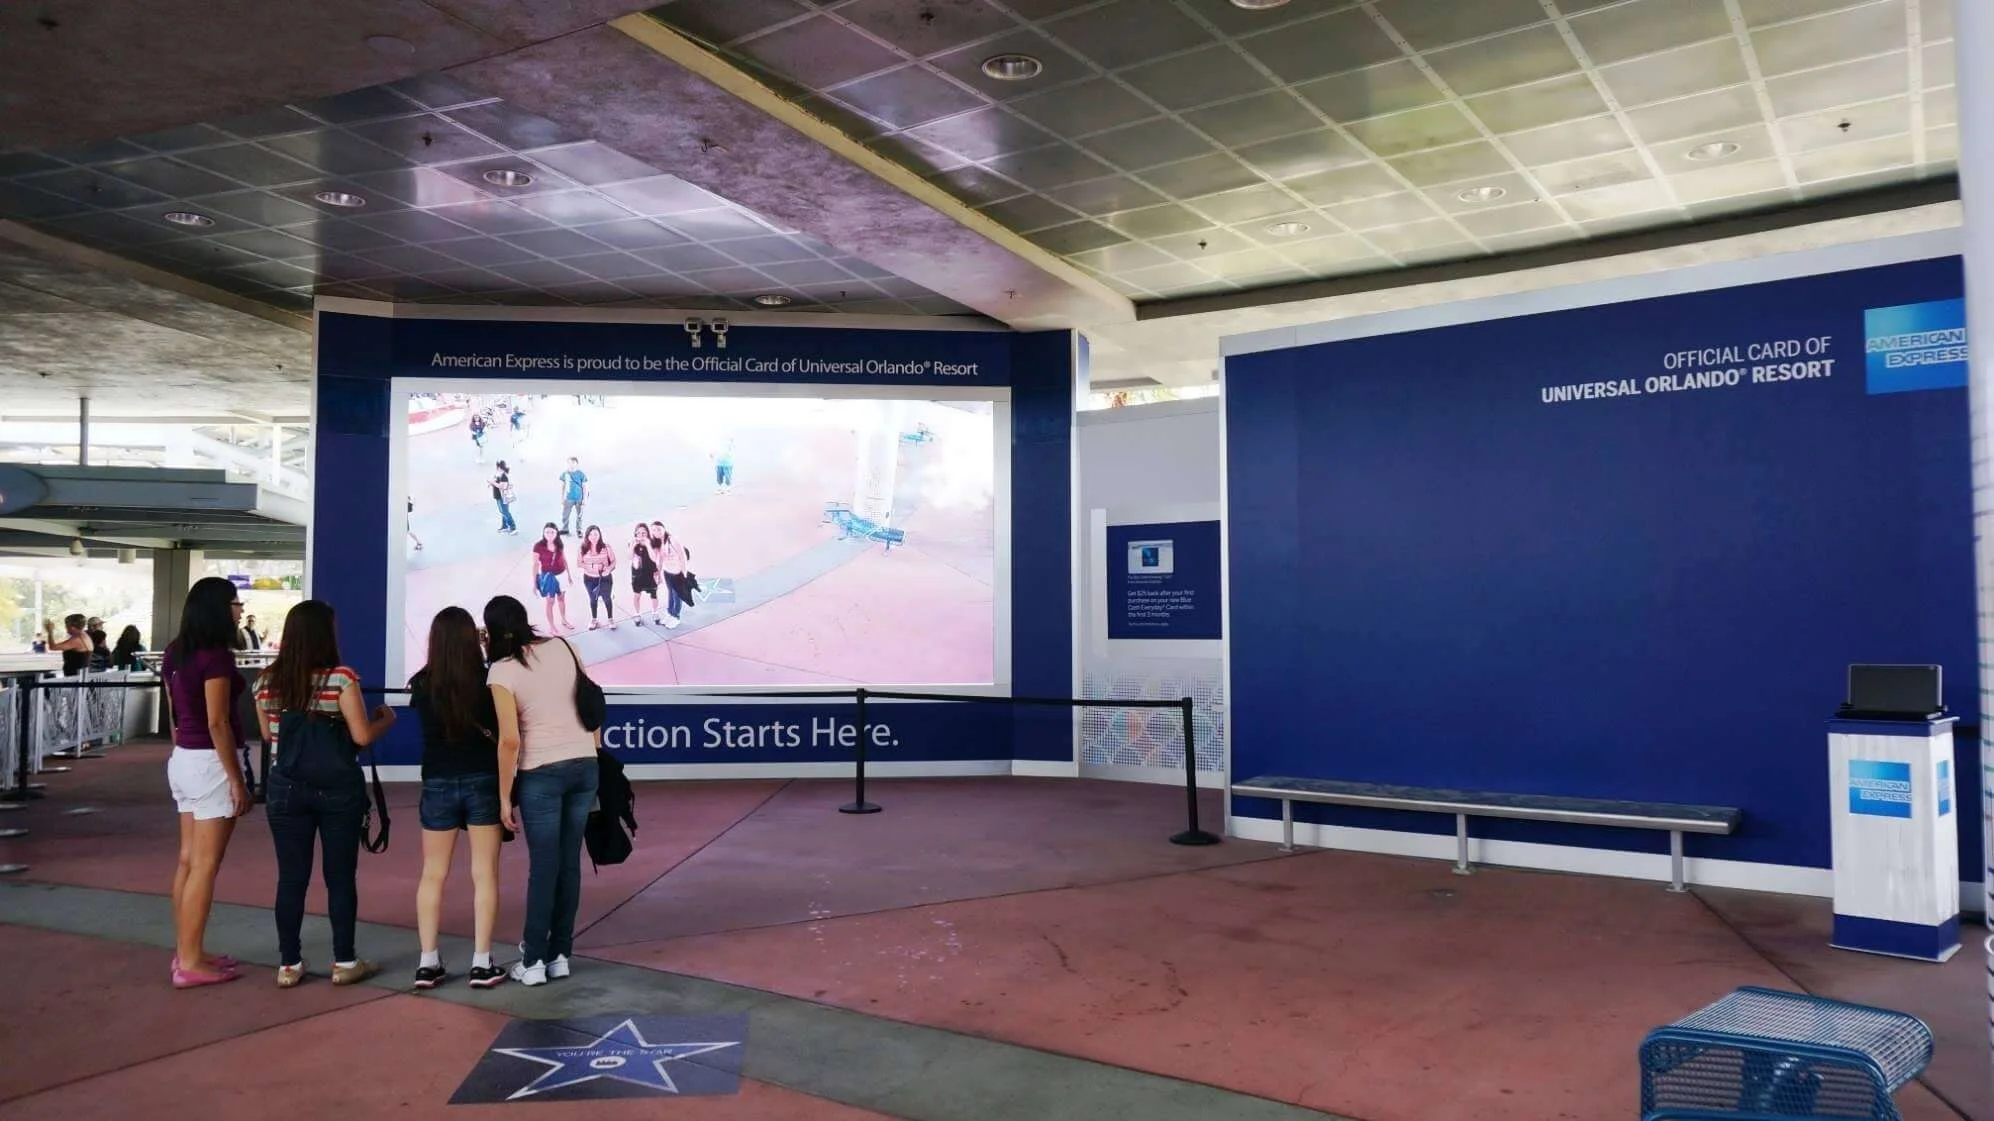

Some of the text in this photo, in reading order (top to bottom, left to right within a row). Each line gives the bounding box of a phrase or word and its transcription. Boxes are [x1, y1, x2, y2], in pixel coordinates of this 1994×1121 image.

[1663, 336, 1832, 371] OFFICIAL CARD OF
[1868, 329, 1966, 352] AMERICAN
[431, 352, 502, 368] American
[506, 354, 560, 373] Express
[563, 355, 574, 369] is
[577, 355, 622, 372] proud
[625, 357, 639, 370] to
[643, 356, 662, 371] be
[665, 356, 689, 371] the
[691, 356, 742, 373] Official
[745, 357, 779, 373] Card
[781, 358, 797, 373] of
[800, 359, 864, 375] Universal
[934, 361, 978, 376] Resort
[1541, 379, 1641, 403] UNIVERSAL
[1752, 359, 1835, 383] RESORT
[600, 717, 691, 749] ction
[703, 717, 801, 749] Starts
